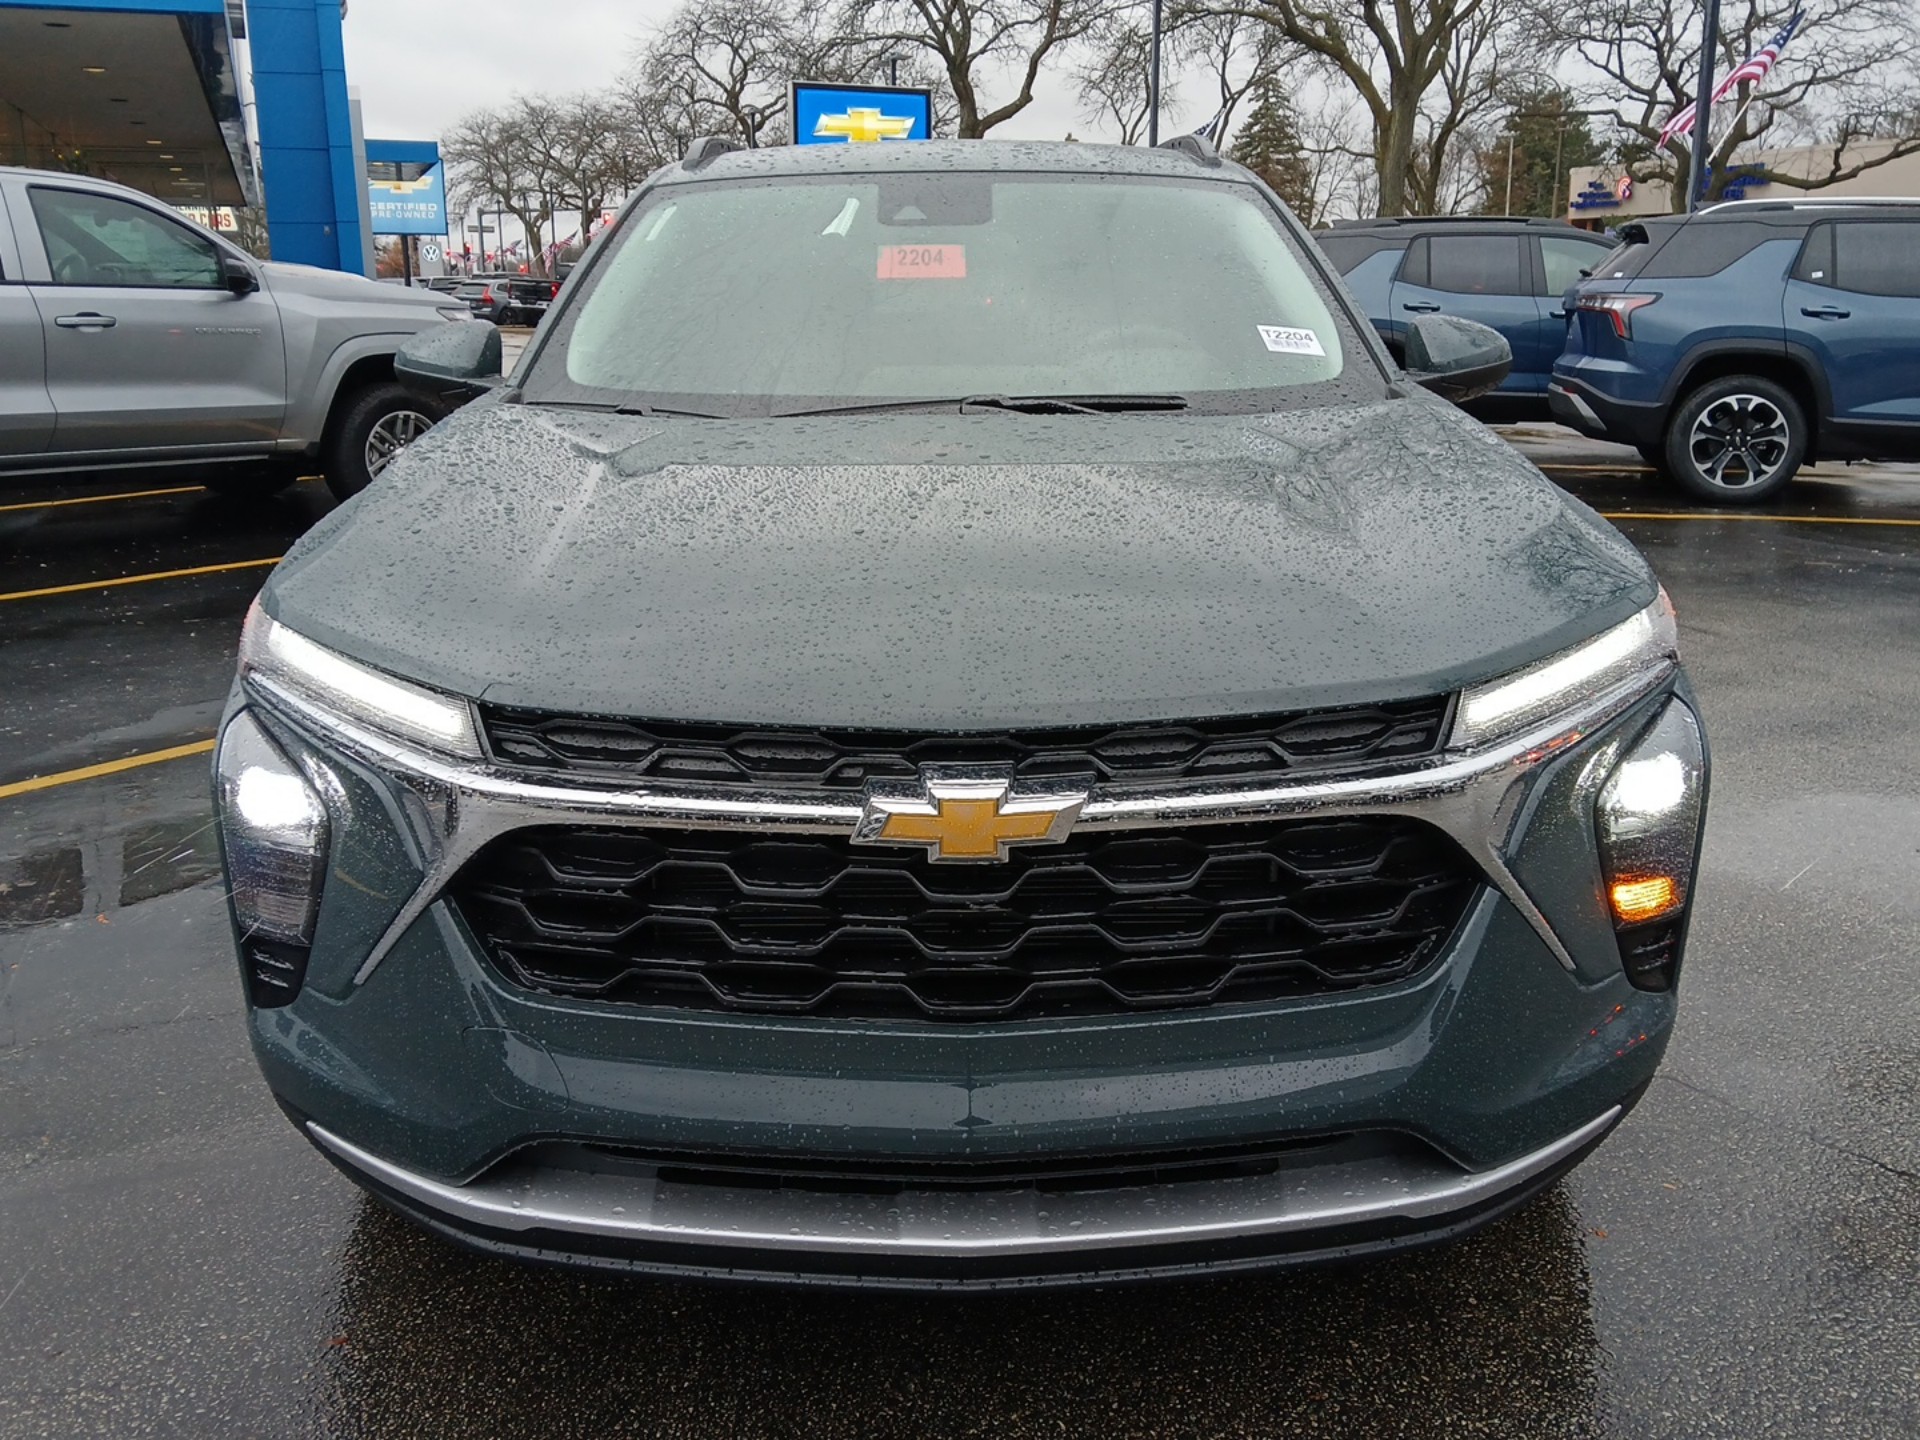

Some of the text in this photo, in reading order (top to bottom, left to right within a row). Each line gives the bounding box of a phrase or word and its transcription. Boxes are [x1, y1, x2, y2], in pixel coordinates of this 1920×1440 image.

[370, 202, 437, 211] CERTIFIED
[898, 248, 943, 266] 2204
[1261, 329, 1313, 342] T2204
